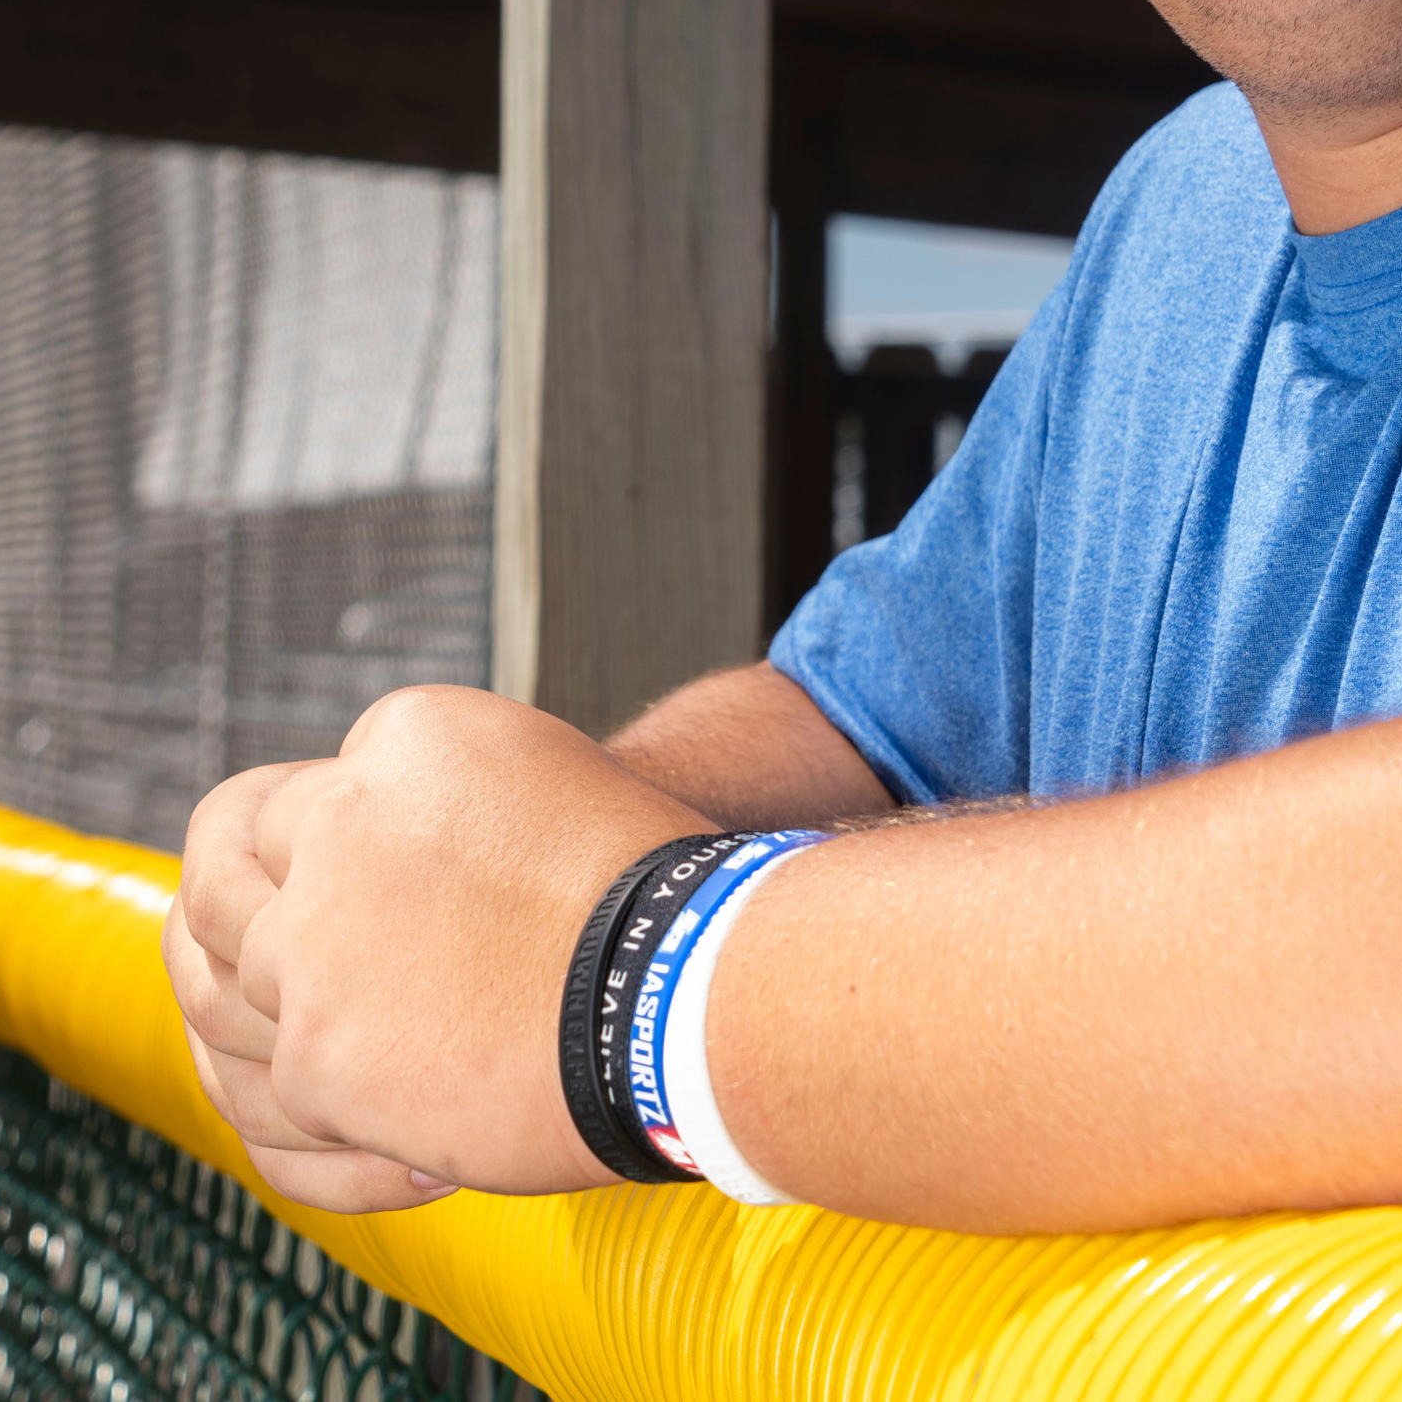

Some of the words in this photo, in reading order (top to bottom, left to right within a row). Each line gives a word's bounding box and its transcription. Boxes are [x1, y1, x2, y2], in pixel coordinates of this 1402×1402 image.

[622, 917, 653, 951] IN
[564, 936, 599, 1012] OWN
[630, 962, 670, 1127] IASPORTZ
